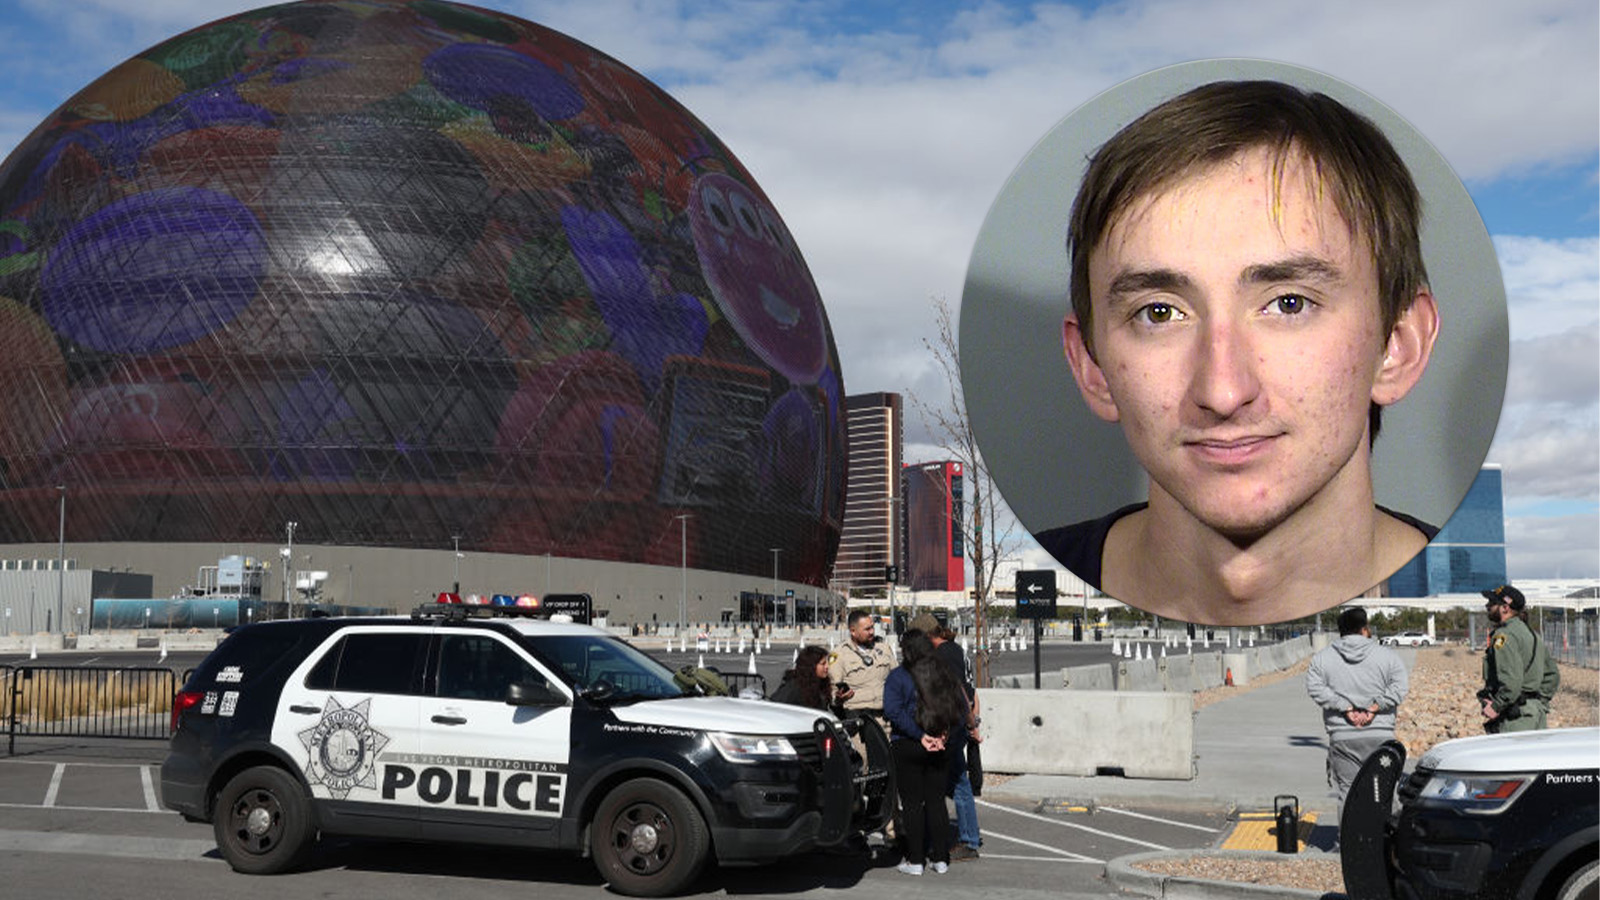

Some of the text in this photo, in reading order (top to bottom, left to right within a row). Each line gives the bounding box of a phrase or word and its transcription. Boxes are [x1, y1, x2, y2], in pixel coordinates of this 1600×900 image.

[311, 711, 374, 752] METROPOLITAN
[397, 754, 557, 772] LAS VEGAS METROPOLITAN
[321, 772, 361, 789] POLICE
[1546, 773, 1593, 784] Partners
[382, 764, 561, 813] POLICE
